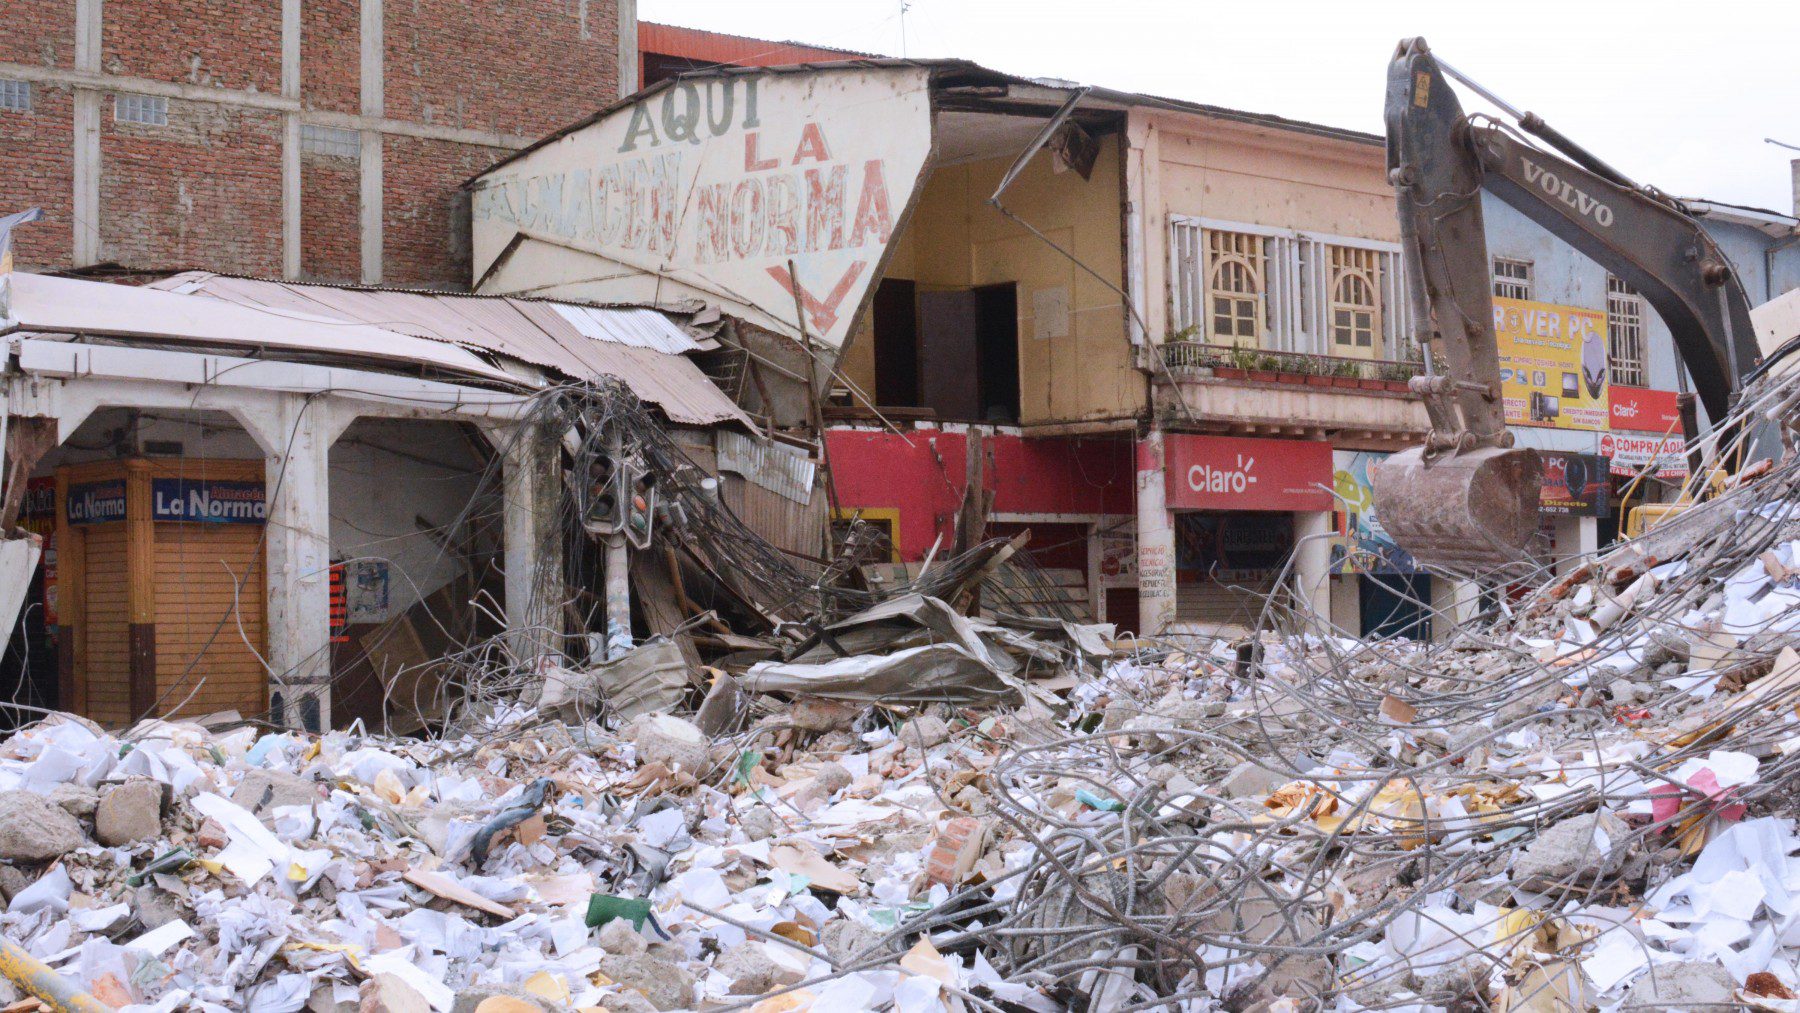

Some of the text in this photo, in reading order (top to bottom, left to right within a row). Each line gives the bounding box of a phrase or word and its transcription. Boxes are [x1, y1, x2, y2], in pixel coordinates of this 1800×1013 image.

[617, 76, 761, 154] AQUI
[744, 122, 832, 173] LA
[1520, 156, 1614, 227] VOLVO
[695, 159, 894, 264] NORMA
[1568, 313, 1594, 343] PC
[1613, 403, 1635, 419] Claro
[1616, 438, 1660, 454] COMPRA
[1549, 457, 1565, 469] PC
[1187, 464, 1247, 493] Claro
[69, 497, 83, 519] La
[85, 491, 125, 519] Norma
[156, 489, 267, 518] La Norma
[1544, 499, 1588, 507] Directo
